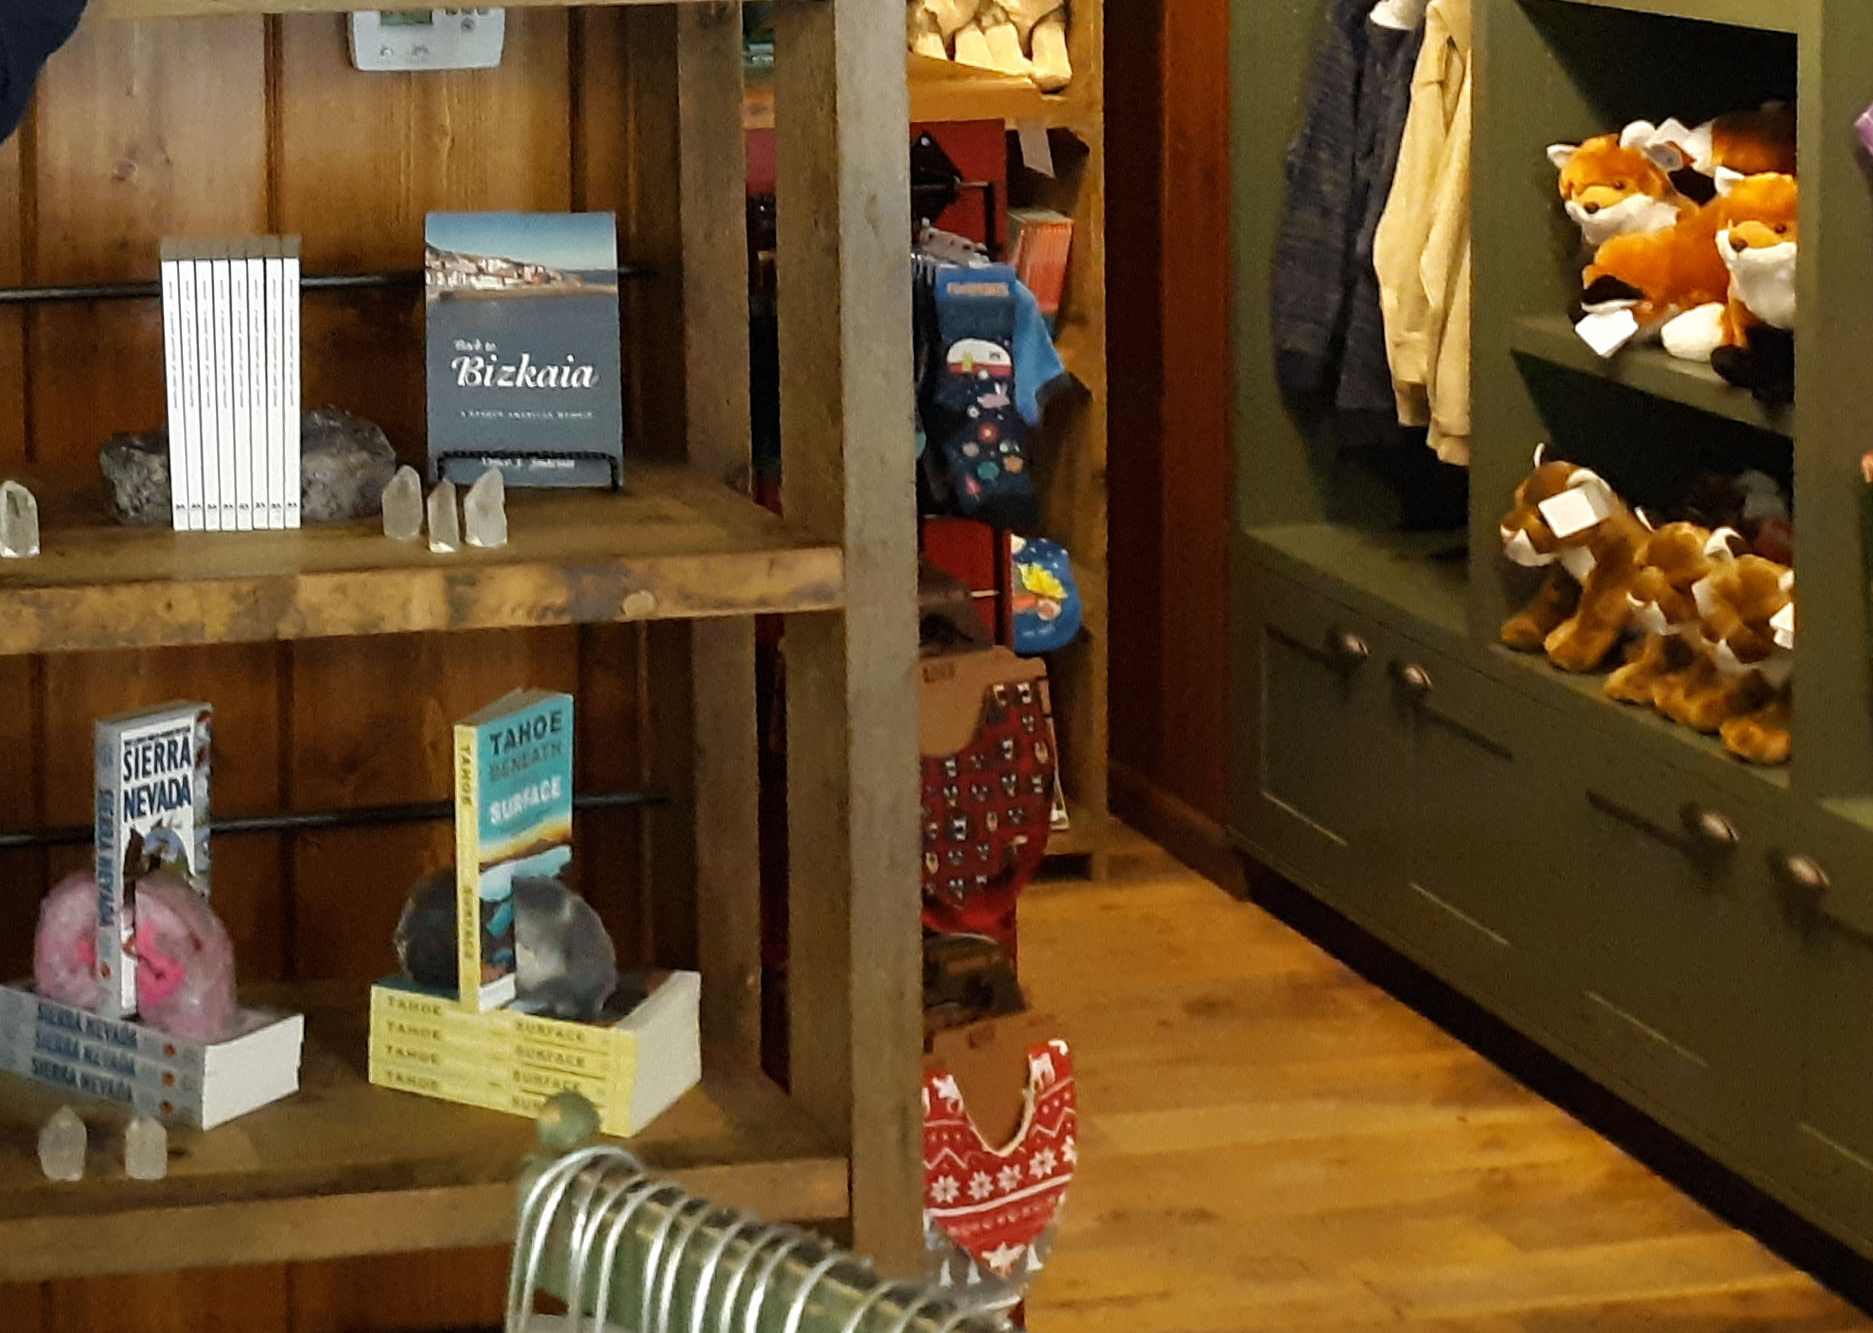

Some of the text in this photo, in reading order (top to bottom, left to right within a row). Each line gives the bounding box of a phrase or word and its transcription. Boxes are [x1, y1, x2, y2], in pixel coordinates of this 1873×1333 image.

[451, 353, 600, 388] Bizkaia
[489, 709, 563, 756] TAHOE
[123, 736, 192, 783] SIERRA
[460, 744, 473, 806] TAHOE
[123, 774, 192, 823] NEVADA
[490, 775, 561, 825] SURFACE
